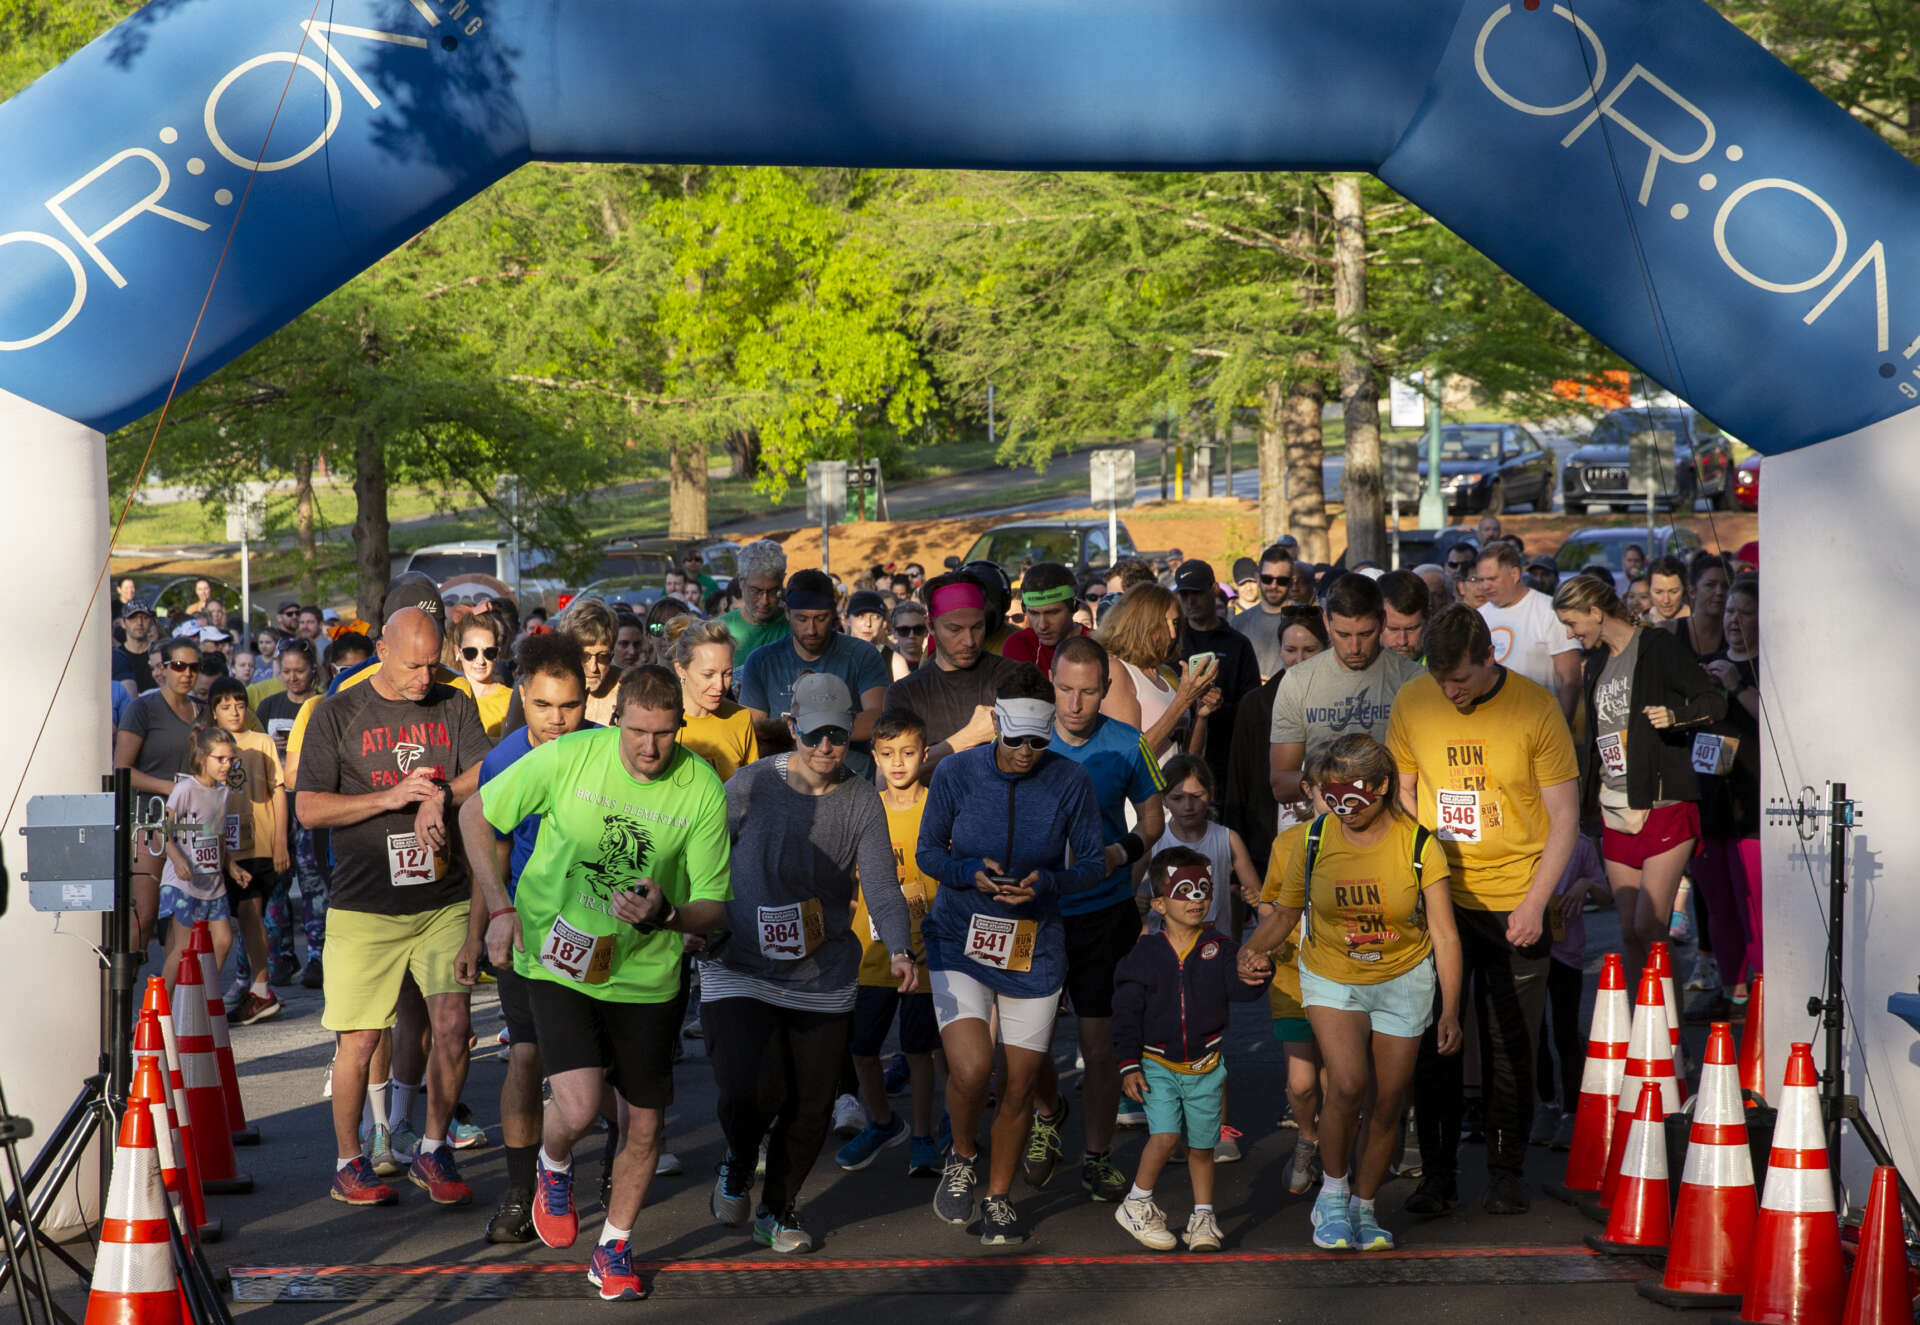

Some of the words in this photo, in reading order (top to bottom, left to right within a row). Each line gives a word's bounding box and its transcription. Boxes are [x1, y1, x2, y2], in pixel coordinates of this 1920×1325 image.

[1354, 704, 1391, 721] SERIE
[362, 722, 450, 757] ATLANTA
[1447, 746, 1483, 766] RUN
[1603, 746, 1621, 763] 548
[1696, 745, 1715, 760] 401
[1464, 776, 1486, 791] 5K
[576, 787, 617, 809] BROOKS
[1442, 805, 1475, 824] 546
[1481, 805, 1497, 815] RUN
[1489, 816, 1500, 827] 5K
[196, 847, 217, 862] 303
[396, 849, 428, 868] 127
[577, 890, 616, 918] TRAC
[1335, 885, 1381, 907] RUN
[764, 922, 799, 942] 364
[1357, 914, 1386, 933] 5K
[972, 931, 1006, 952] 541
[1016, 934, 1032, 945] RUN
[551, 936, 588, 963] 187
